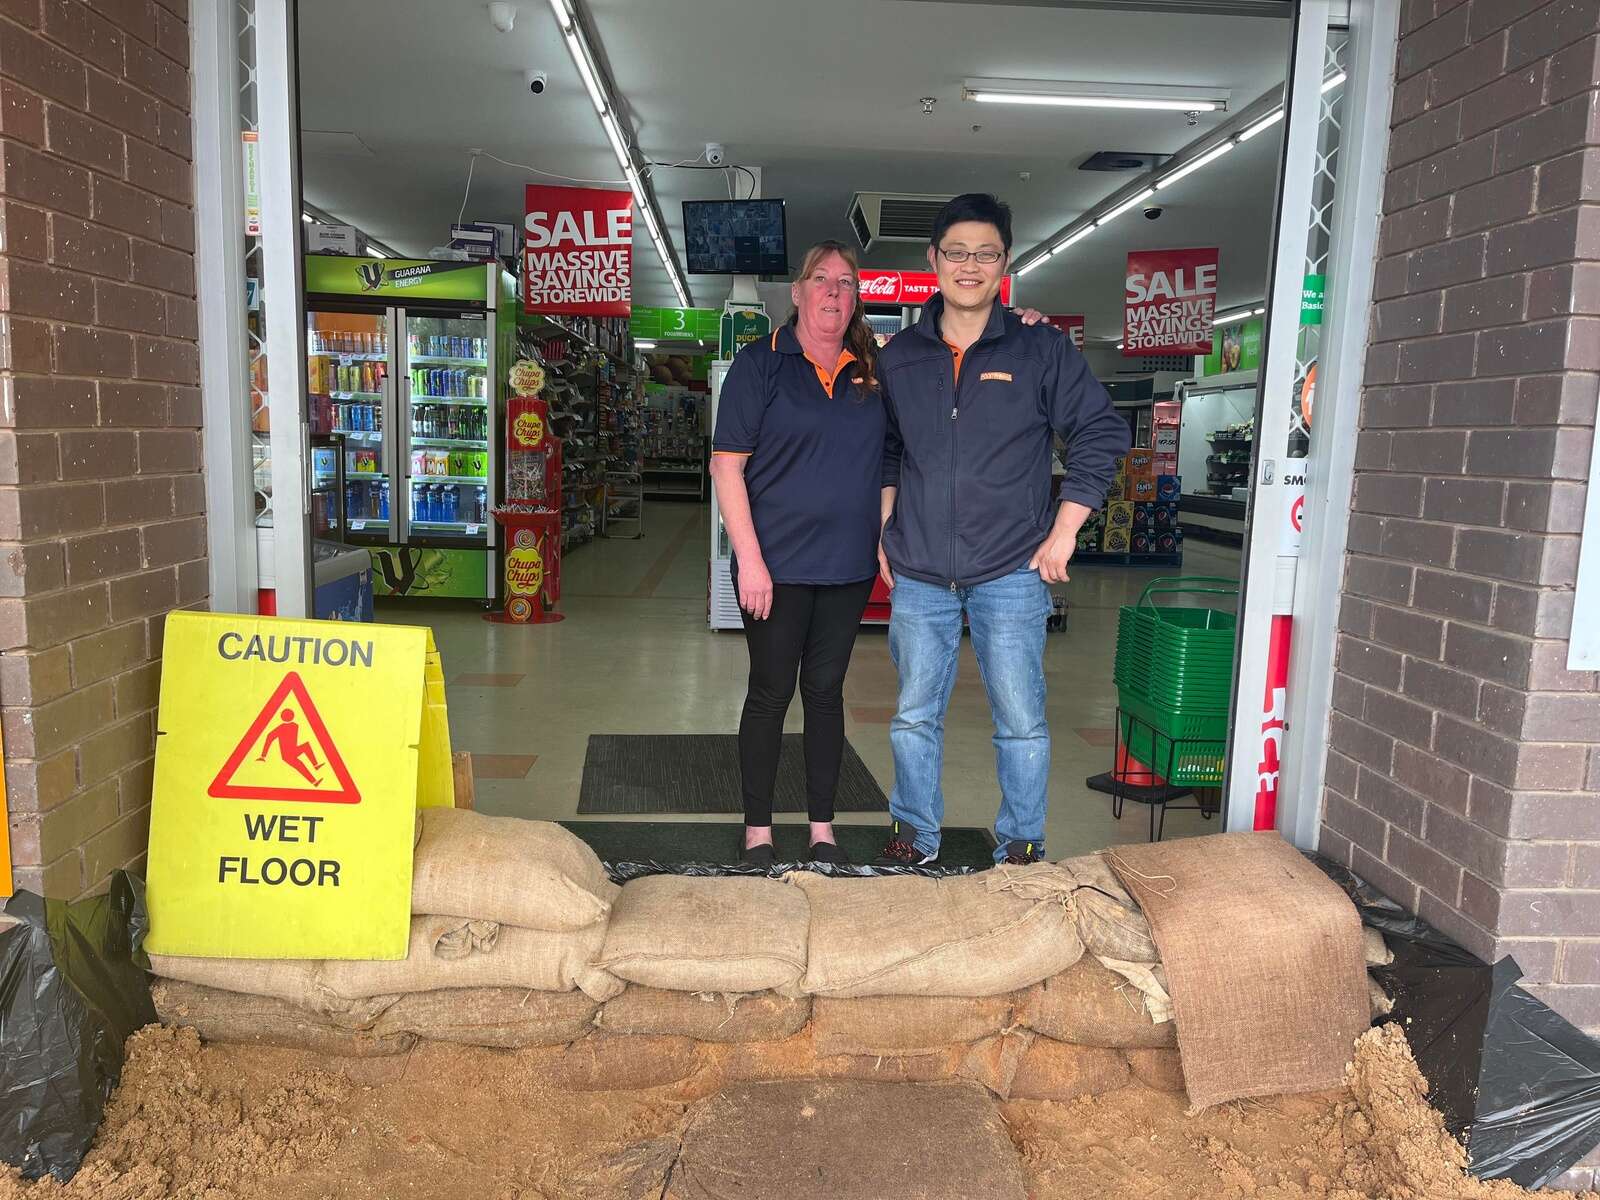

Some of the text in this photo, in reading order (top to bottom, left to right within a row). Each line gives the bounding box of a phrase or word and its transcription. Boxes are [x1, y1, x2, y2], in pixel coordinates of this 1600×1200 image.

[525, 209, 632, 248] SALE
[527, 250, 630, 271] MASSIVE
[395, 265, 431, 278] GUARANA
[528, 268, 631, 290] SAVINGS
[395, 277, 423, 288] ENERGY
[904, 285, 928, 293] TASTE
[1126, 264, 1217, 304] SALE
[530, 287, 632, 304] STOREWIDE
[1303, 290, 1317, 298] We
[1126, 298, 1213, 322] MASSIVE
[673, 310, 686, 330] 3
[1127, 315, 1213, 338] SAVINGS
[1128, 329, 1214, 349] STOREWIDE
[515, 368, 541, 379] Chupa
[514, 377, 540, 391] Chups
[517, 420, 541, 429] Chupa
[516, 428, 540, 441] Chups
[508, 557, 541, 572] Chupa
[506, 569, 540, 588] Chups
[217, 632, 373, 667] CAUTION
[244, 814, 324, 843] WET
[218, 856, 341, 887] FLOOR
